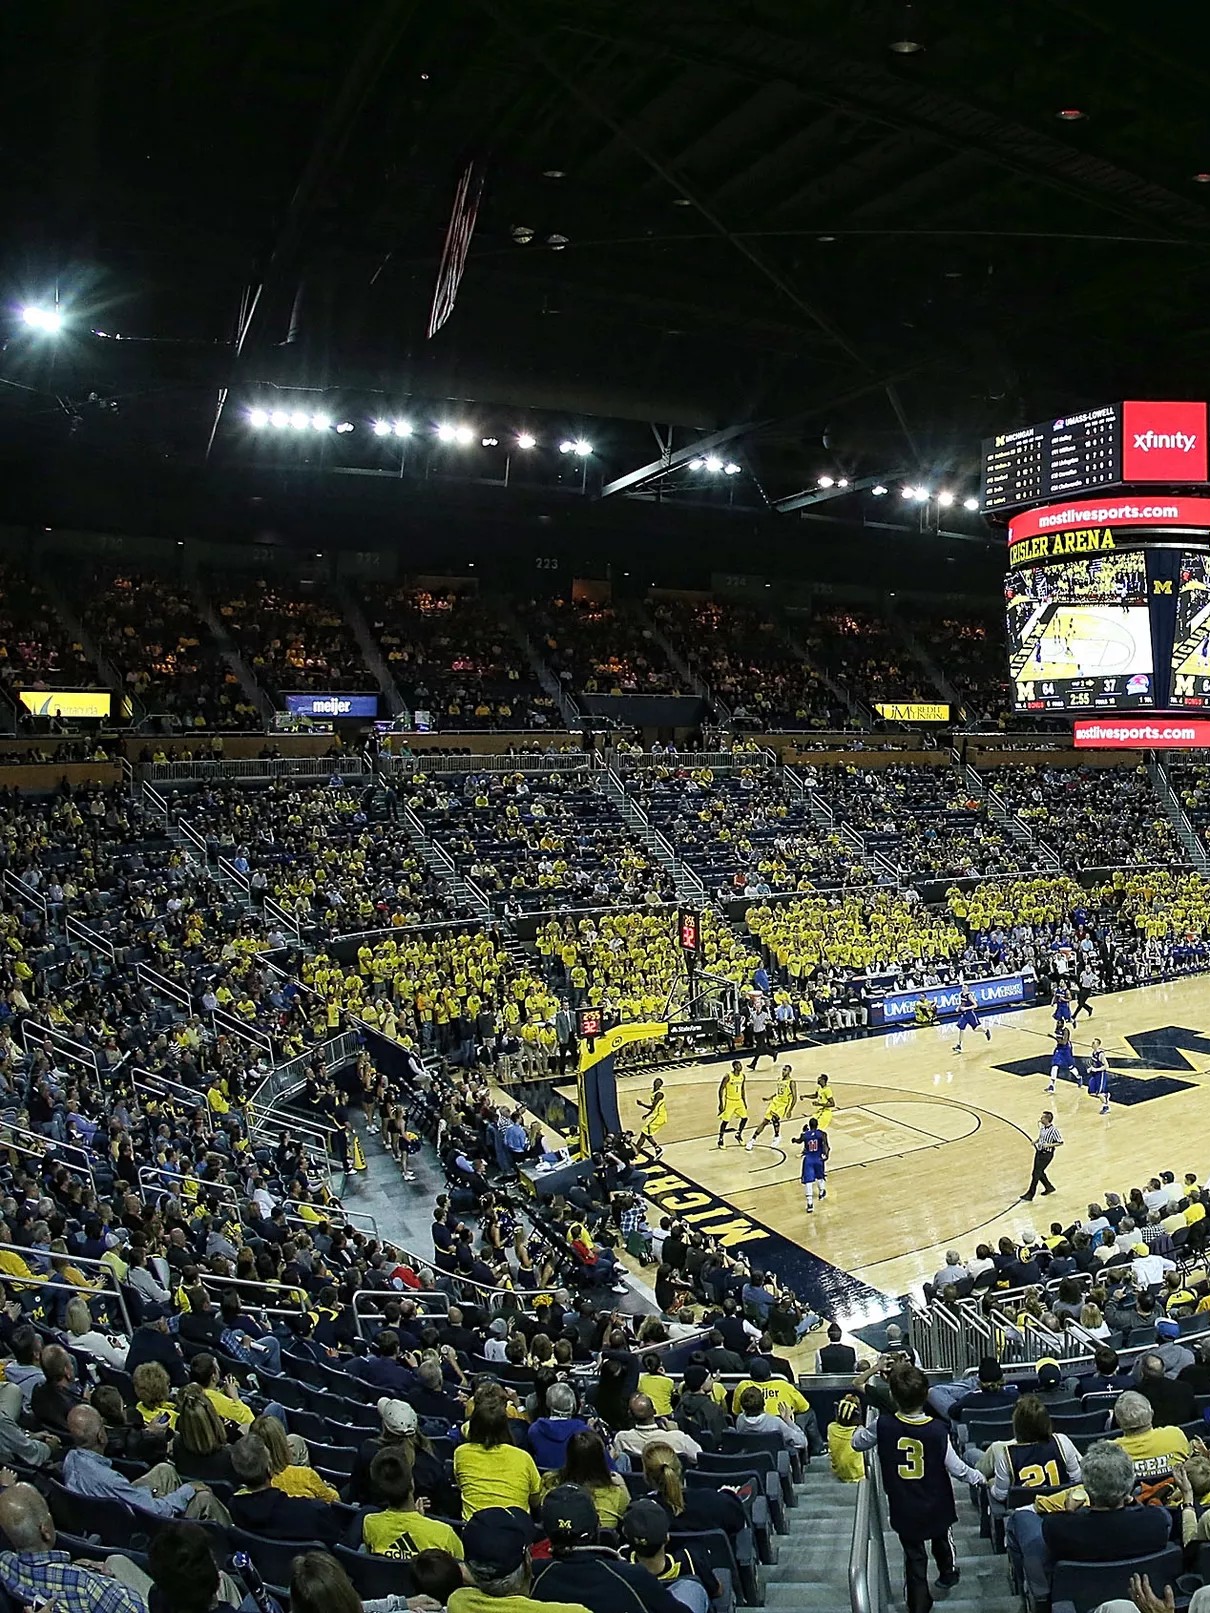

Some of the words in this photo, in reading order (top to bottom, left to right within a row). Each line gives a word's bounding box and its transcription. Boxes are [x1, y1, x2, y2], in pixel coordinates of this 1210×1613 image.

[1065, 407, 1114, 426] UMASS-LOWELL
[1006, 428, 1034, 443] MICHIGAN
[1039, 506, 1178, 528] mostlivesports.com
[1052, 528, 1116, 554] ARENA
[536, 557, 558, 570] 223
[1154, 580, 1172, 594] M
[1016, 682, 1035, 701] M
[1042, 682, 1055, 695] 64
[1104, 679, 1116, 692] 37
[1174, 675, 1195, 696] M
[312, 697, 350, 715] meijer
[1070, 693, 1089, 705] 2:55
[981, 986, 1001, 1000] UM
[583, 1011, 600, 1020] 2:55
[884, 1002, 906, 1016] UM
[583, 1021, 597, 1033] 32
[808, 1140, 818, 1152] 11
[762, 1388, 780, 1400] ijer
[897, 1436, 924, 1480] 3
[1019, 1460, 1060, 1487] 21
[558, 1519, 571, 1529] M
